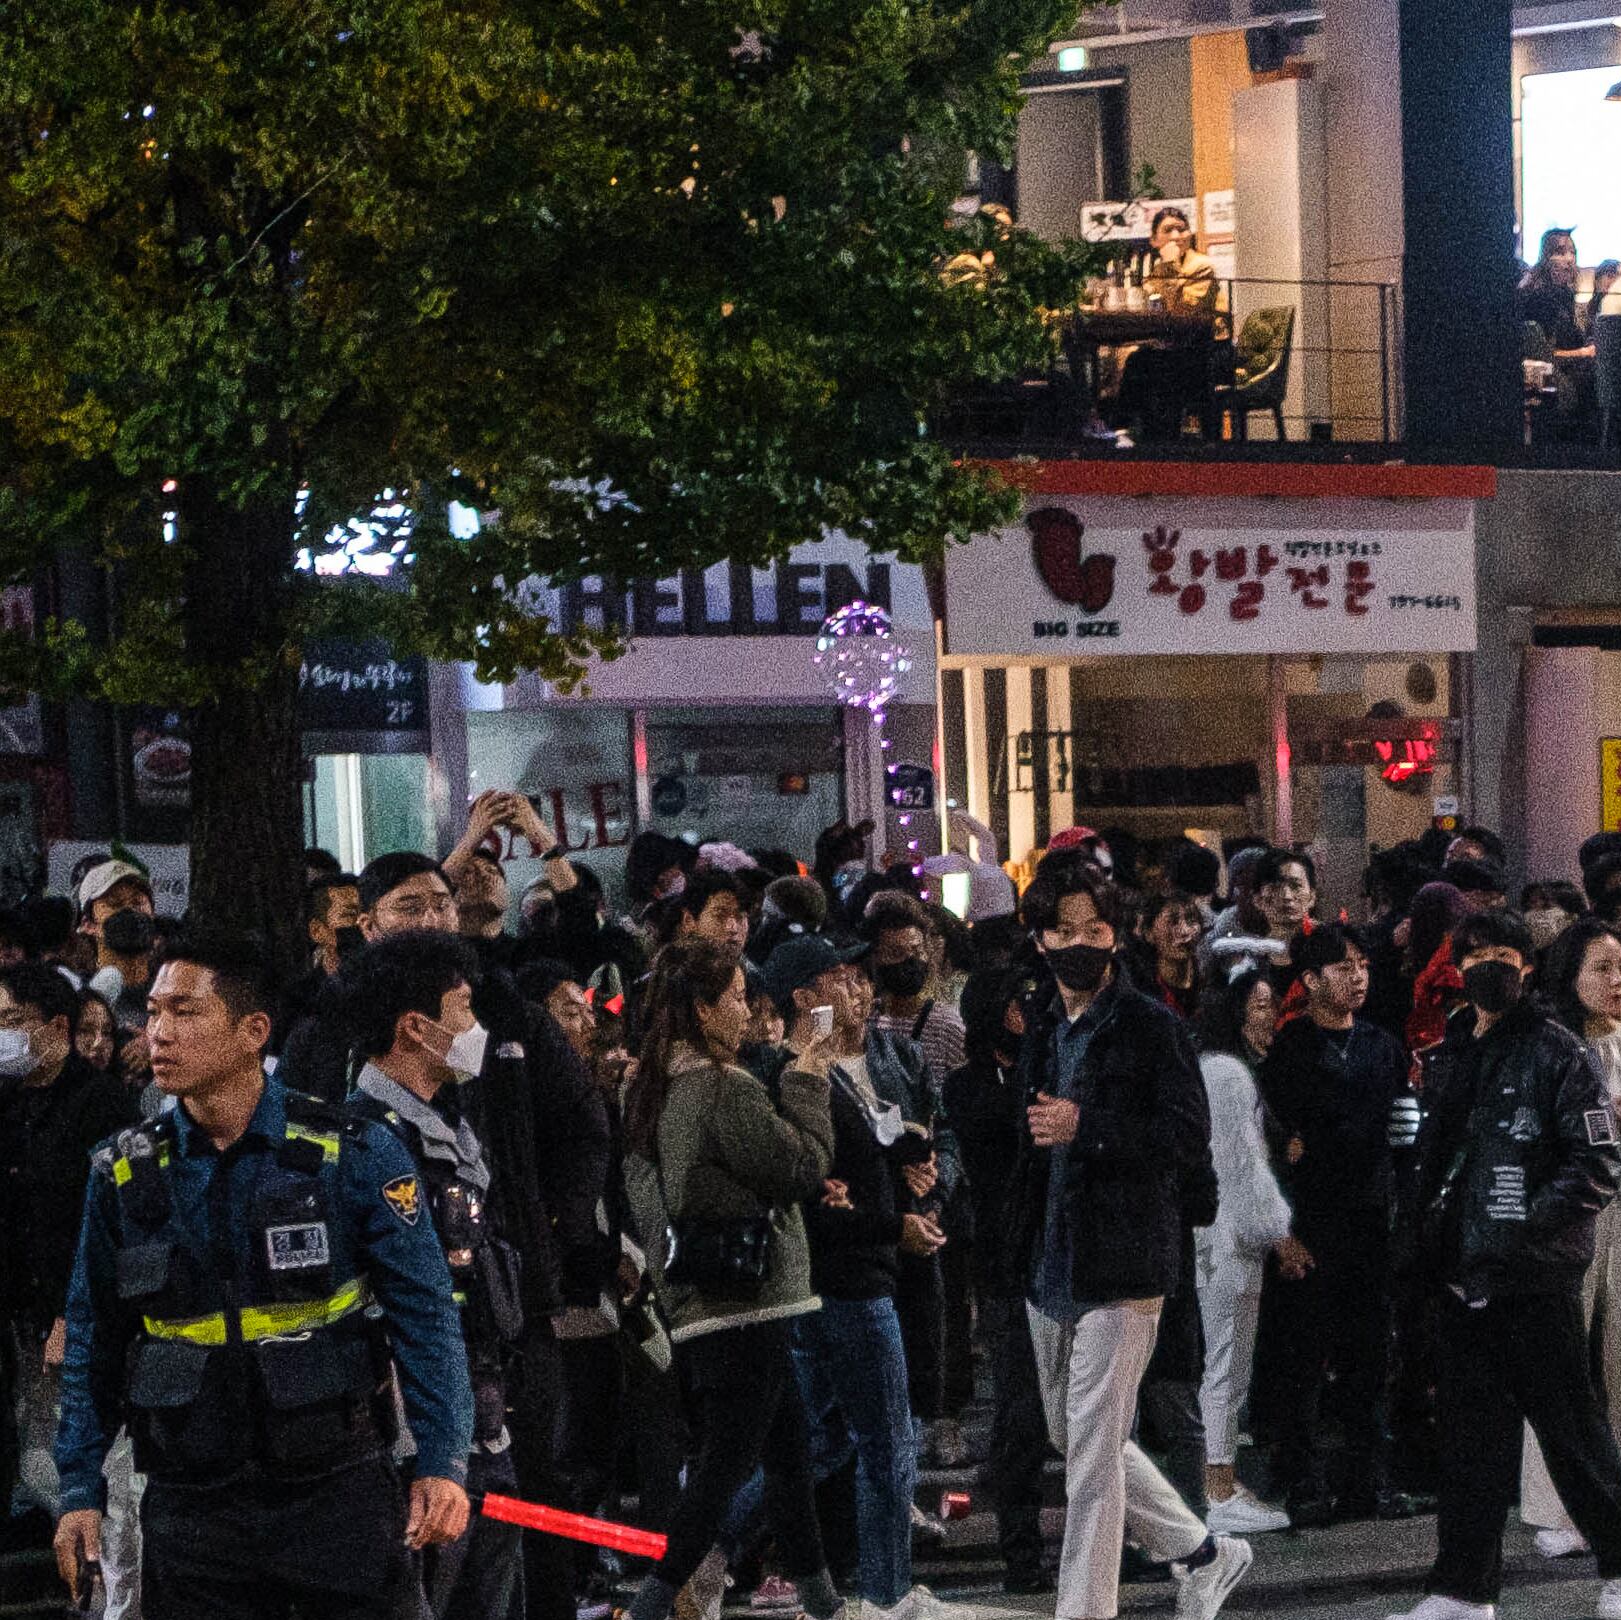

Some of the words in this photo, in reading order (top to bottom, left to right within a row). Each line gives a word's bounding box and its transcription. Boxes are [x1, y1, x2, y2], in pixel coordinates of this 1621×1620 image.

[1143, 527, 1278, 620] 왕발
[1034, 621, 1067, 638] BIG
[1076, 620, 1120, 638] SIZE
